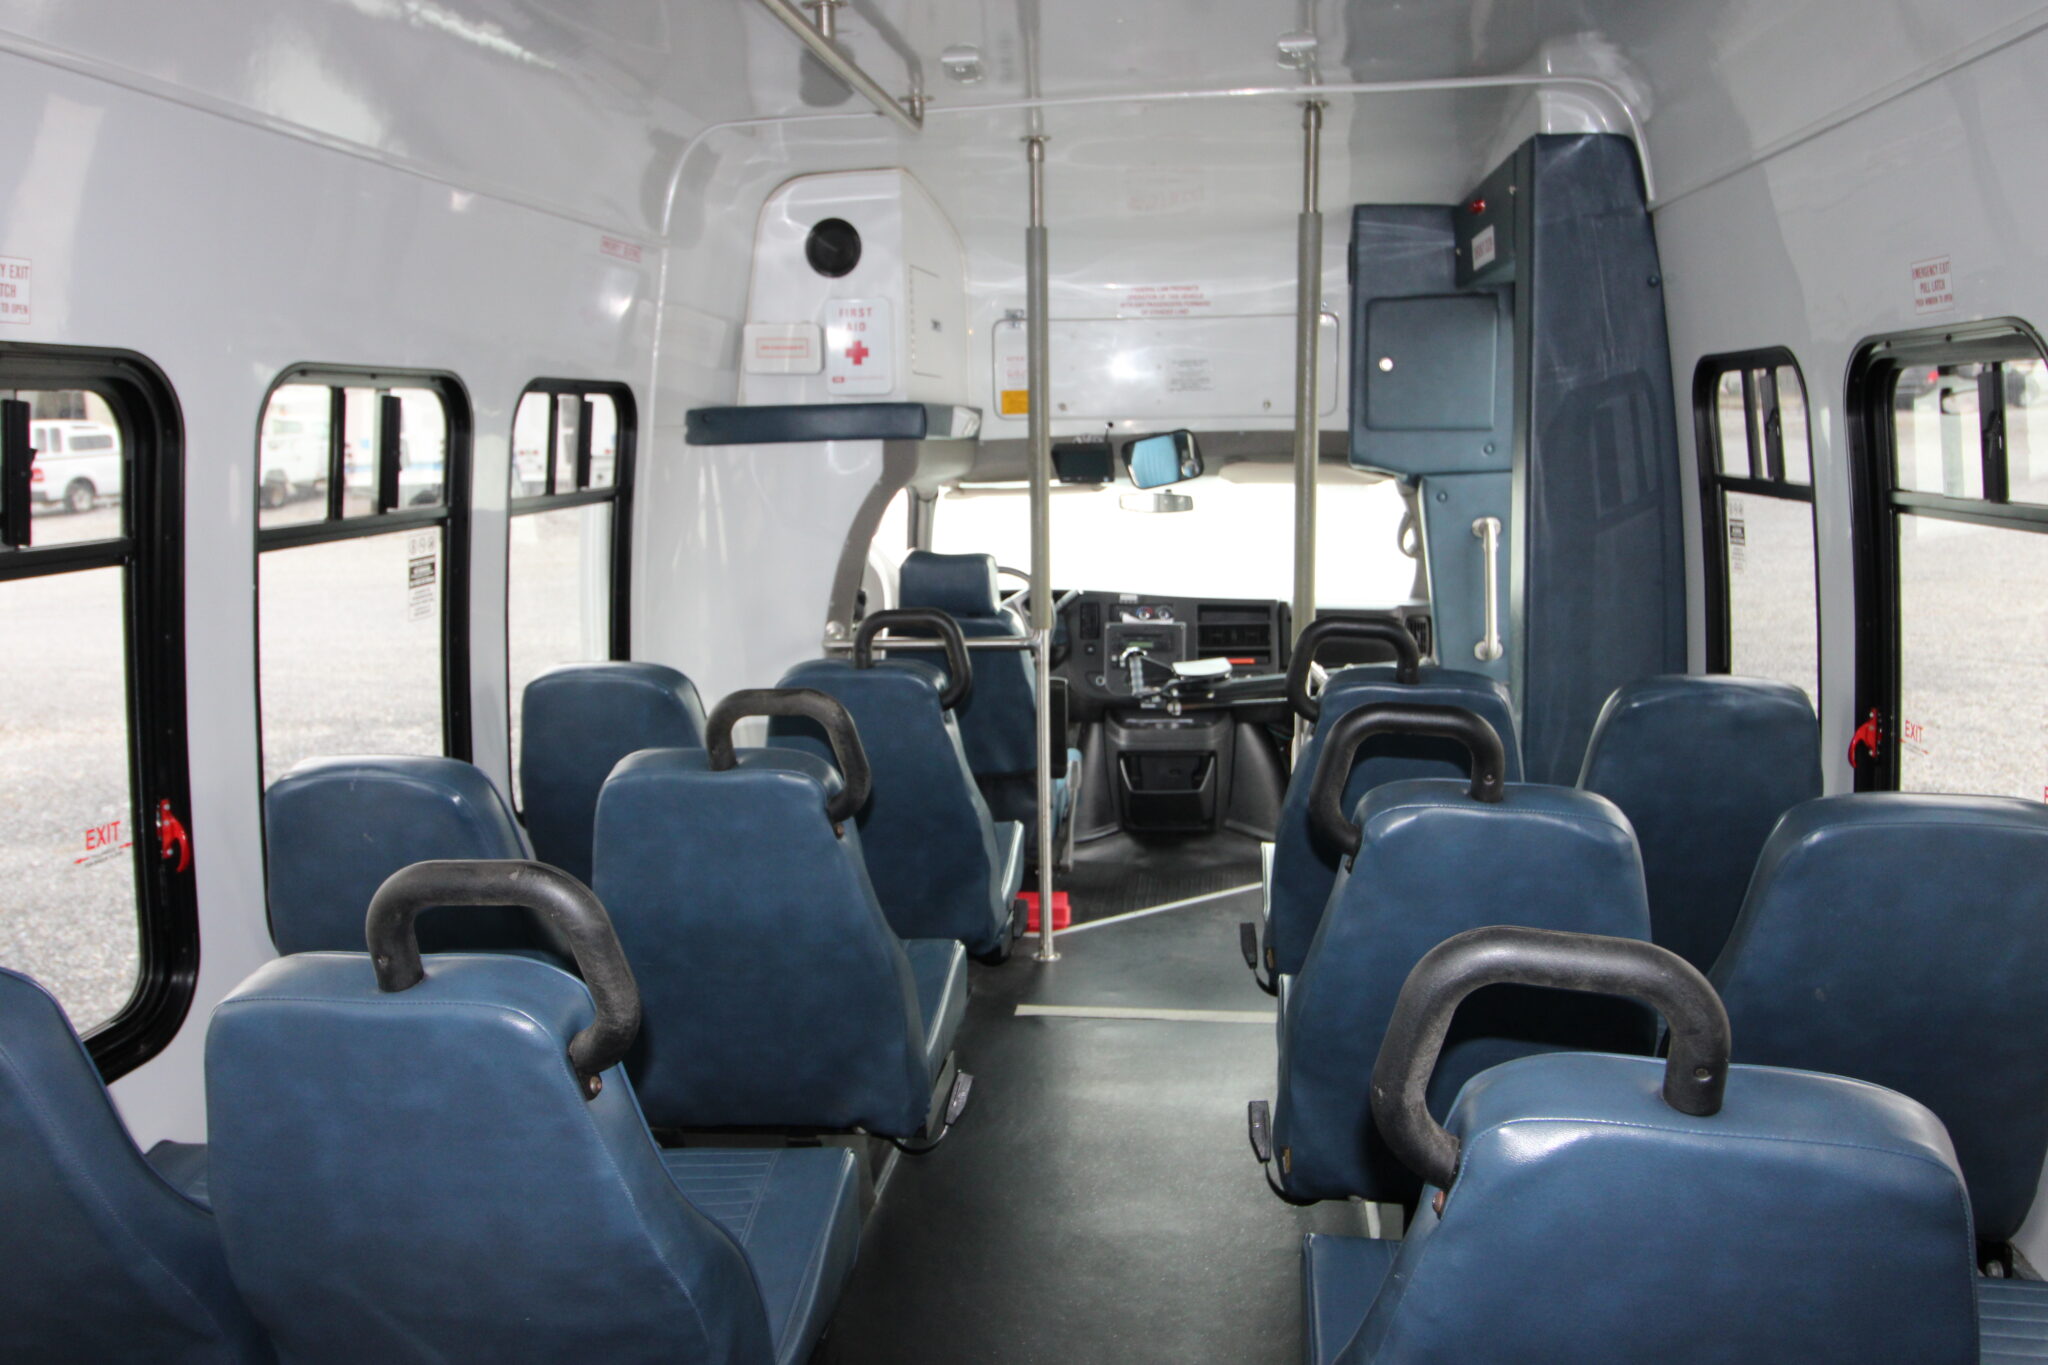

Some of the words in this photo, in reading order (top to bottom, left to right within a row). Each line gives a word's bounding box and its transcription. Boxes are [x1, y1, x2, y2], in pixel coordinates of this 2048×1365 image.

[9, 264, 29, 280] EXIT
[838, 307, 872, 318] FIRST
[1905, 719, 1924, 743] EXIT
[85, 820, 121, 851] EXIT
